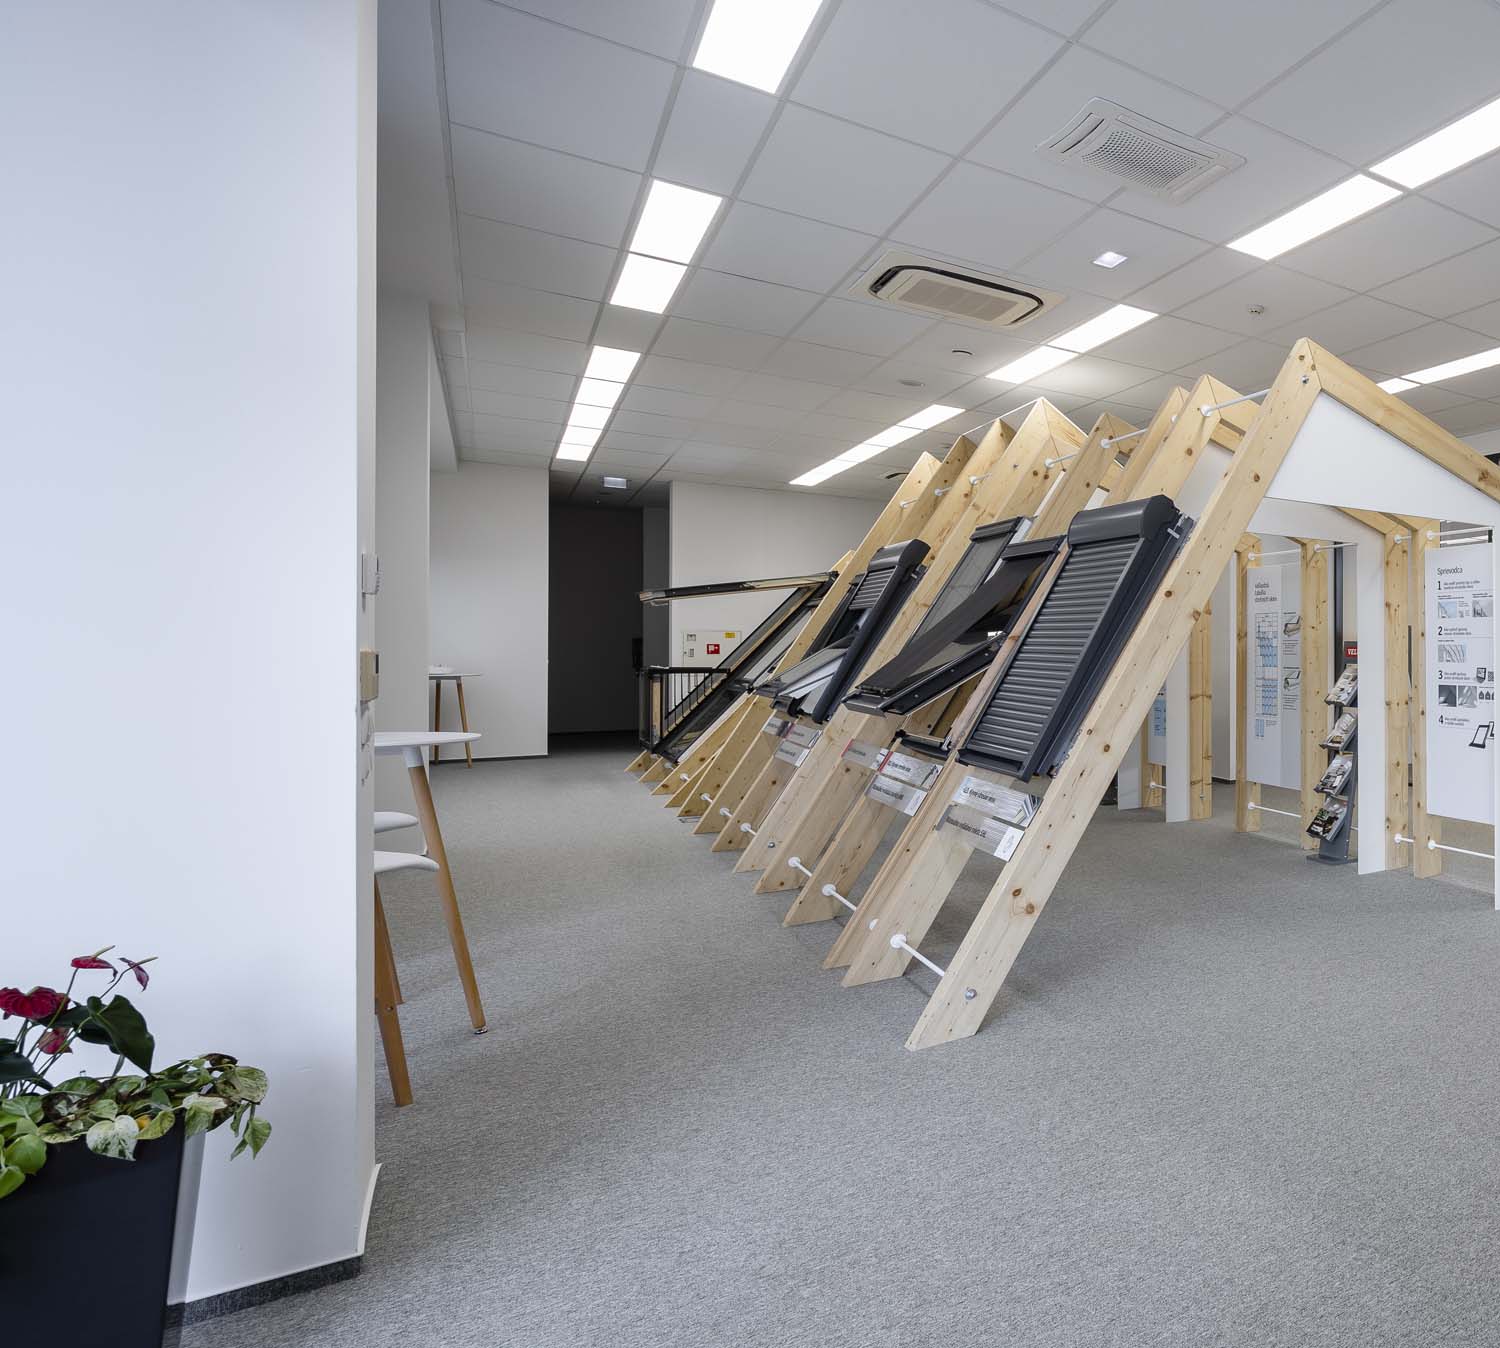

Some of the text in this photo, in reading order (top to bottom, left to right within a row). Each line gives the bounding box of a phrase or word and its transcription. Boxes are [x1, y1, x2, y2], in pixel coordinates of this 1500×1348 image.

[1437, 581, 1442, 590] 1
[1438, 626, 1443, 636] 2
[1438, 670, 1443, 680] 3
[1438, 715, 1444, 724] 4
